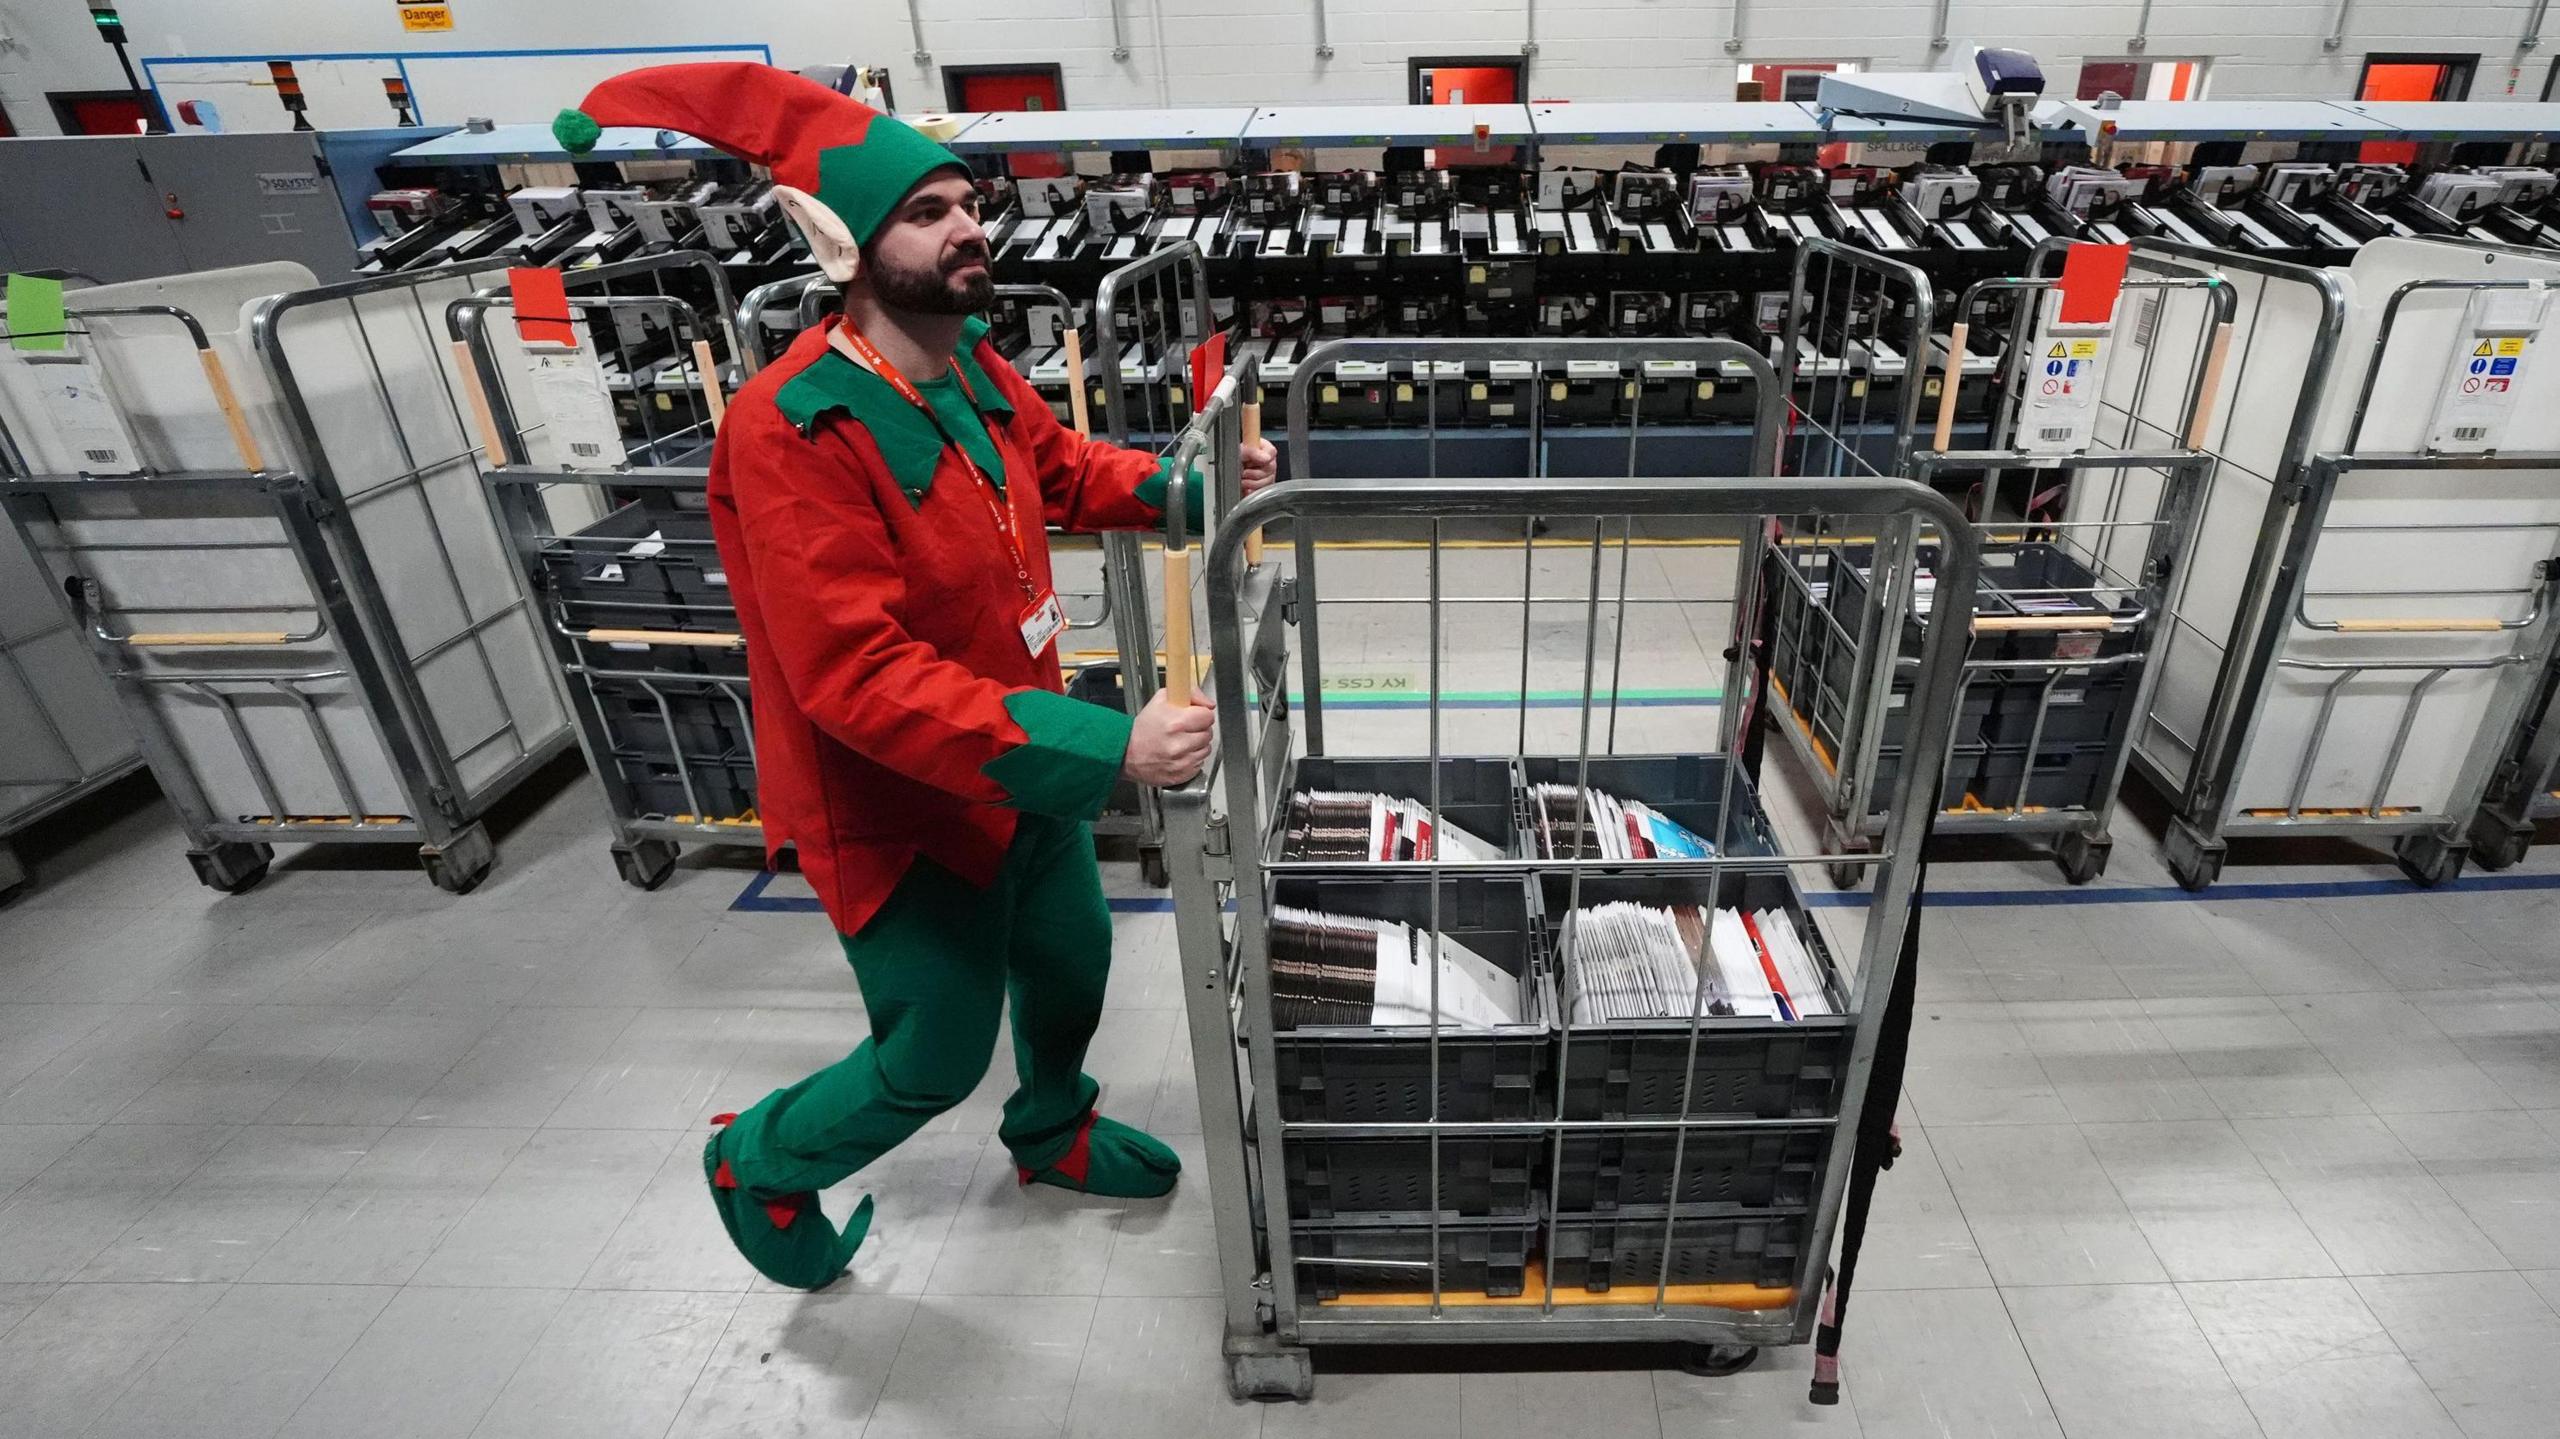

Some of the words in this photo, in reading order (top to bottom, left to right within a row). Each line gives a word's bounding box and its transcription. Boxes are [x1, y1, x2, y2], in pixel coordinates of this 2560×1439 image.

[403, 9, 445, 22] Danger
[1902, 102, 1910, 112] 2
[1867, 142, 1931, 152] SPILLAGES
[271, 177, 318, 190] SOLYSTIC
[1337, 678, 1375, 689] CSS
[1381, 677, 1406, 688] KY
